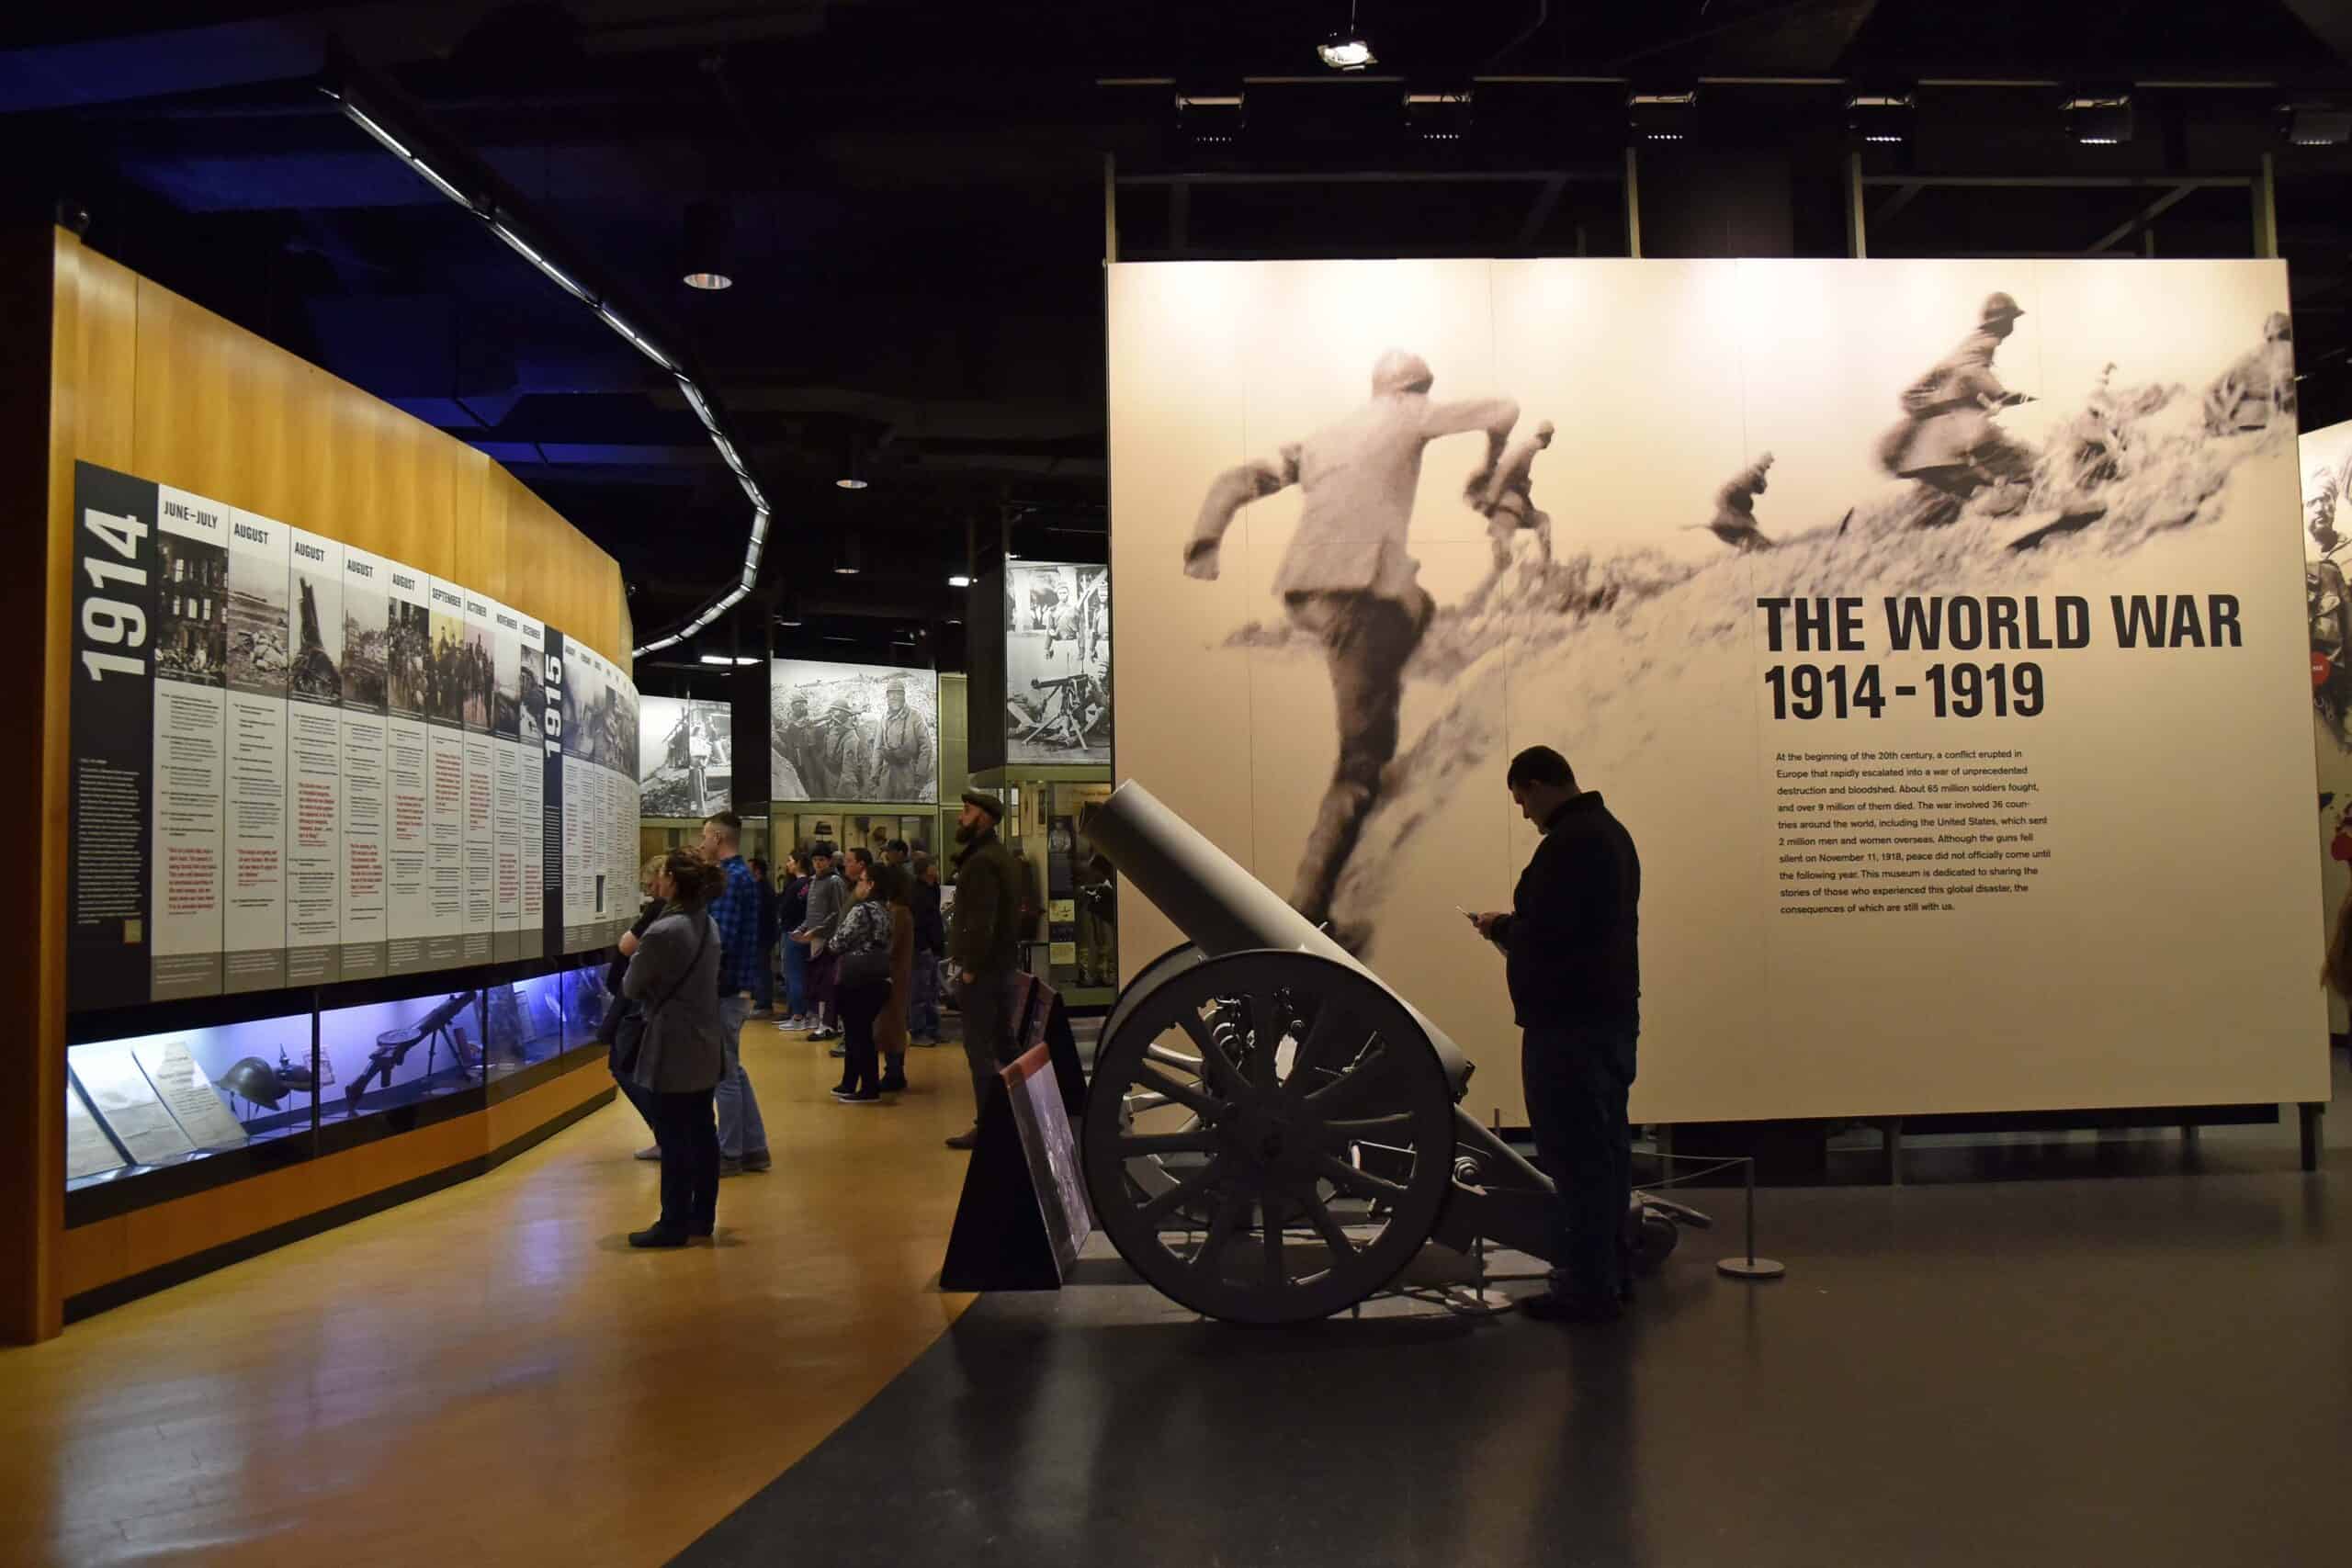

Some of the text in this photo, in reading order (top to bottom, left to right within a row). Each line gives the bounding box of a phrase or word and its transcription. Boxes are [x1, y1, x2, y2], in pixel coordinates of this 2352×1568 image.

[235, 523, 268, 545] AUGUST
[294, 541, 324, 562] AUGUST
[347, 559, 373, 578] AUGUST
[393, 574, 415, 592] AUGUST
[83, 509, 148, 682] 1914
[433, 588, 461, 607] SEPTEMBER
[1758, 594, 2243, 651] THE WORLD WAR
[1765, 663, 2044, 719] 1914-1919
[545, 656, 562, 758] 1915
[1777, 752, 1785, 760] At
[1789, 752, 1803, 760] the
[1804, 752, 1848, 762] beginning
[1850, 751, 1859, 759] of
[1861, 751, 1876, 759] the
[1879, 751, 1898, 759] 20th
[1945, 750, 1975, 758] conflict
[1978, 749, 2012, 760] erupted
[2015, 749, 2022, 757] in
[1778, 770, 1808, 780] Europe
[1811, 769, 1827, 777] that
[1830, 769, 1860, 779] rapidly
[1862, 768, 1904, 777] escalated
[1906, 768, 1922, 776] into
[1951, 767, 1960, 775] of
[1962, 766, 2029, 777] unprecedented
[1778, 783, 2040, 795] destruction and bloodshed. About 65 million soldiers fought,
[1778, 804, 1793, 812] and
[1818, 803, 1824, 811] 9
[1826, 803, 1855, 811] million
[1858, 802, 1866, 811] of
[1869, 802, 1892, 810] them
[1918, 801, 1933, 809] The
[1955, 800, 1989, 809] involved
[1992, 800, 2003, 808] 36
[1779, 821, 1797, 829] tries
[1800, 820, 1831, 828] around
[1833, 820, 1848, 828] the
[1850, 819, 1876, 829] world,
[1879, 819, 1918, 829] including
[1921, 818, 1935, 826] the
[1938, 818, 1965, 826] United
[2001, 817, 2026, 825] which
[2029, 816, 2047, 825] sent
[1779, 838, 1784, 846] 2
[1787, 837, 1815, 846] million
[1840, 837, 1857, 845] and
[1938, 835, 1977, 845] Although
[1980, 834, 1994, 842] the
[1996, 836, 2018, 844] guns
[2020, 834, 2034, 842] fell
[1780, 855, 1803, 863] silent
[1819, 854, 1864, 862] November
[1869, 853, 1879, 862] 11,
[1882, 853, 1904, 862] 1918,
[1906, 854, 1933, 863] peace
[1935, 852, 1949, 860] did
[1951, 852, 1965, 860] not
[1968, 851, 2003, 862] officially
[2032, 850, 2050, 859] until
[1780, 872, 1793, 880] the
[1796, 871, 1836, 882] following
[1860, 870, 1880, 878] This
[1923, 869, 1930, 877] is
[1933, 869, 1975, 877] dedicated
[1978, 868, 1987, 877] to
[1989, 868, 2021, 878] sharing
[2024, 868, 2039, 876] the
[1781, 888, 1810, 897] stories
[1813, 888, 1822, 896] of
[1824, 888, 1849, 896] those
[1851, 887, 1870, 896] who
[1872, 887, 1926, 897] experienced
[1928, 886, 1944, 894] this
[1947, 886, 1973, 896] global
[2015, 885, 2029, 893] the
[1781, 906, 1845, 915] consequences
[1848, 904, 1856, 912] of
[1859, 904, 1884, 912] which
[1904, 903, 1918, 911] still
[1921, 903, 1939, 911] with
